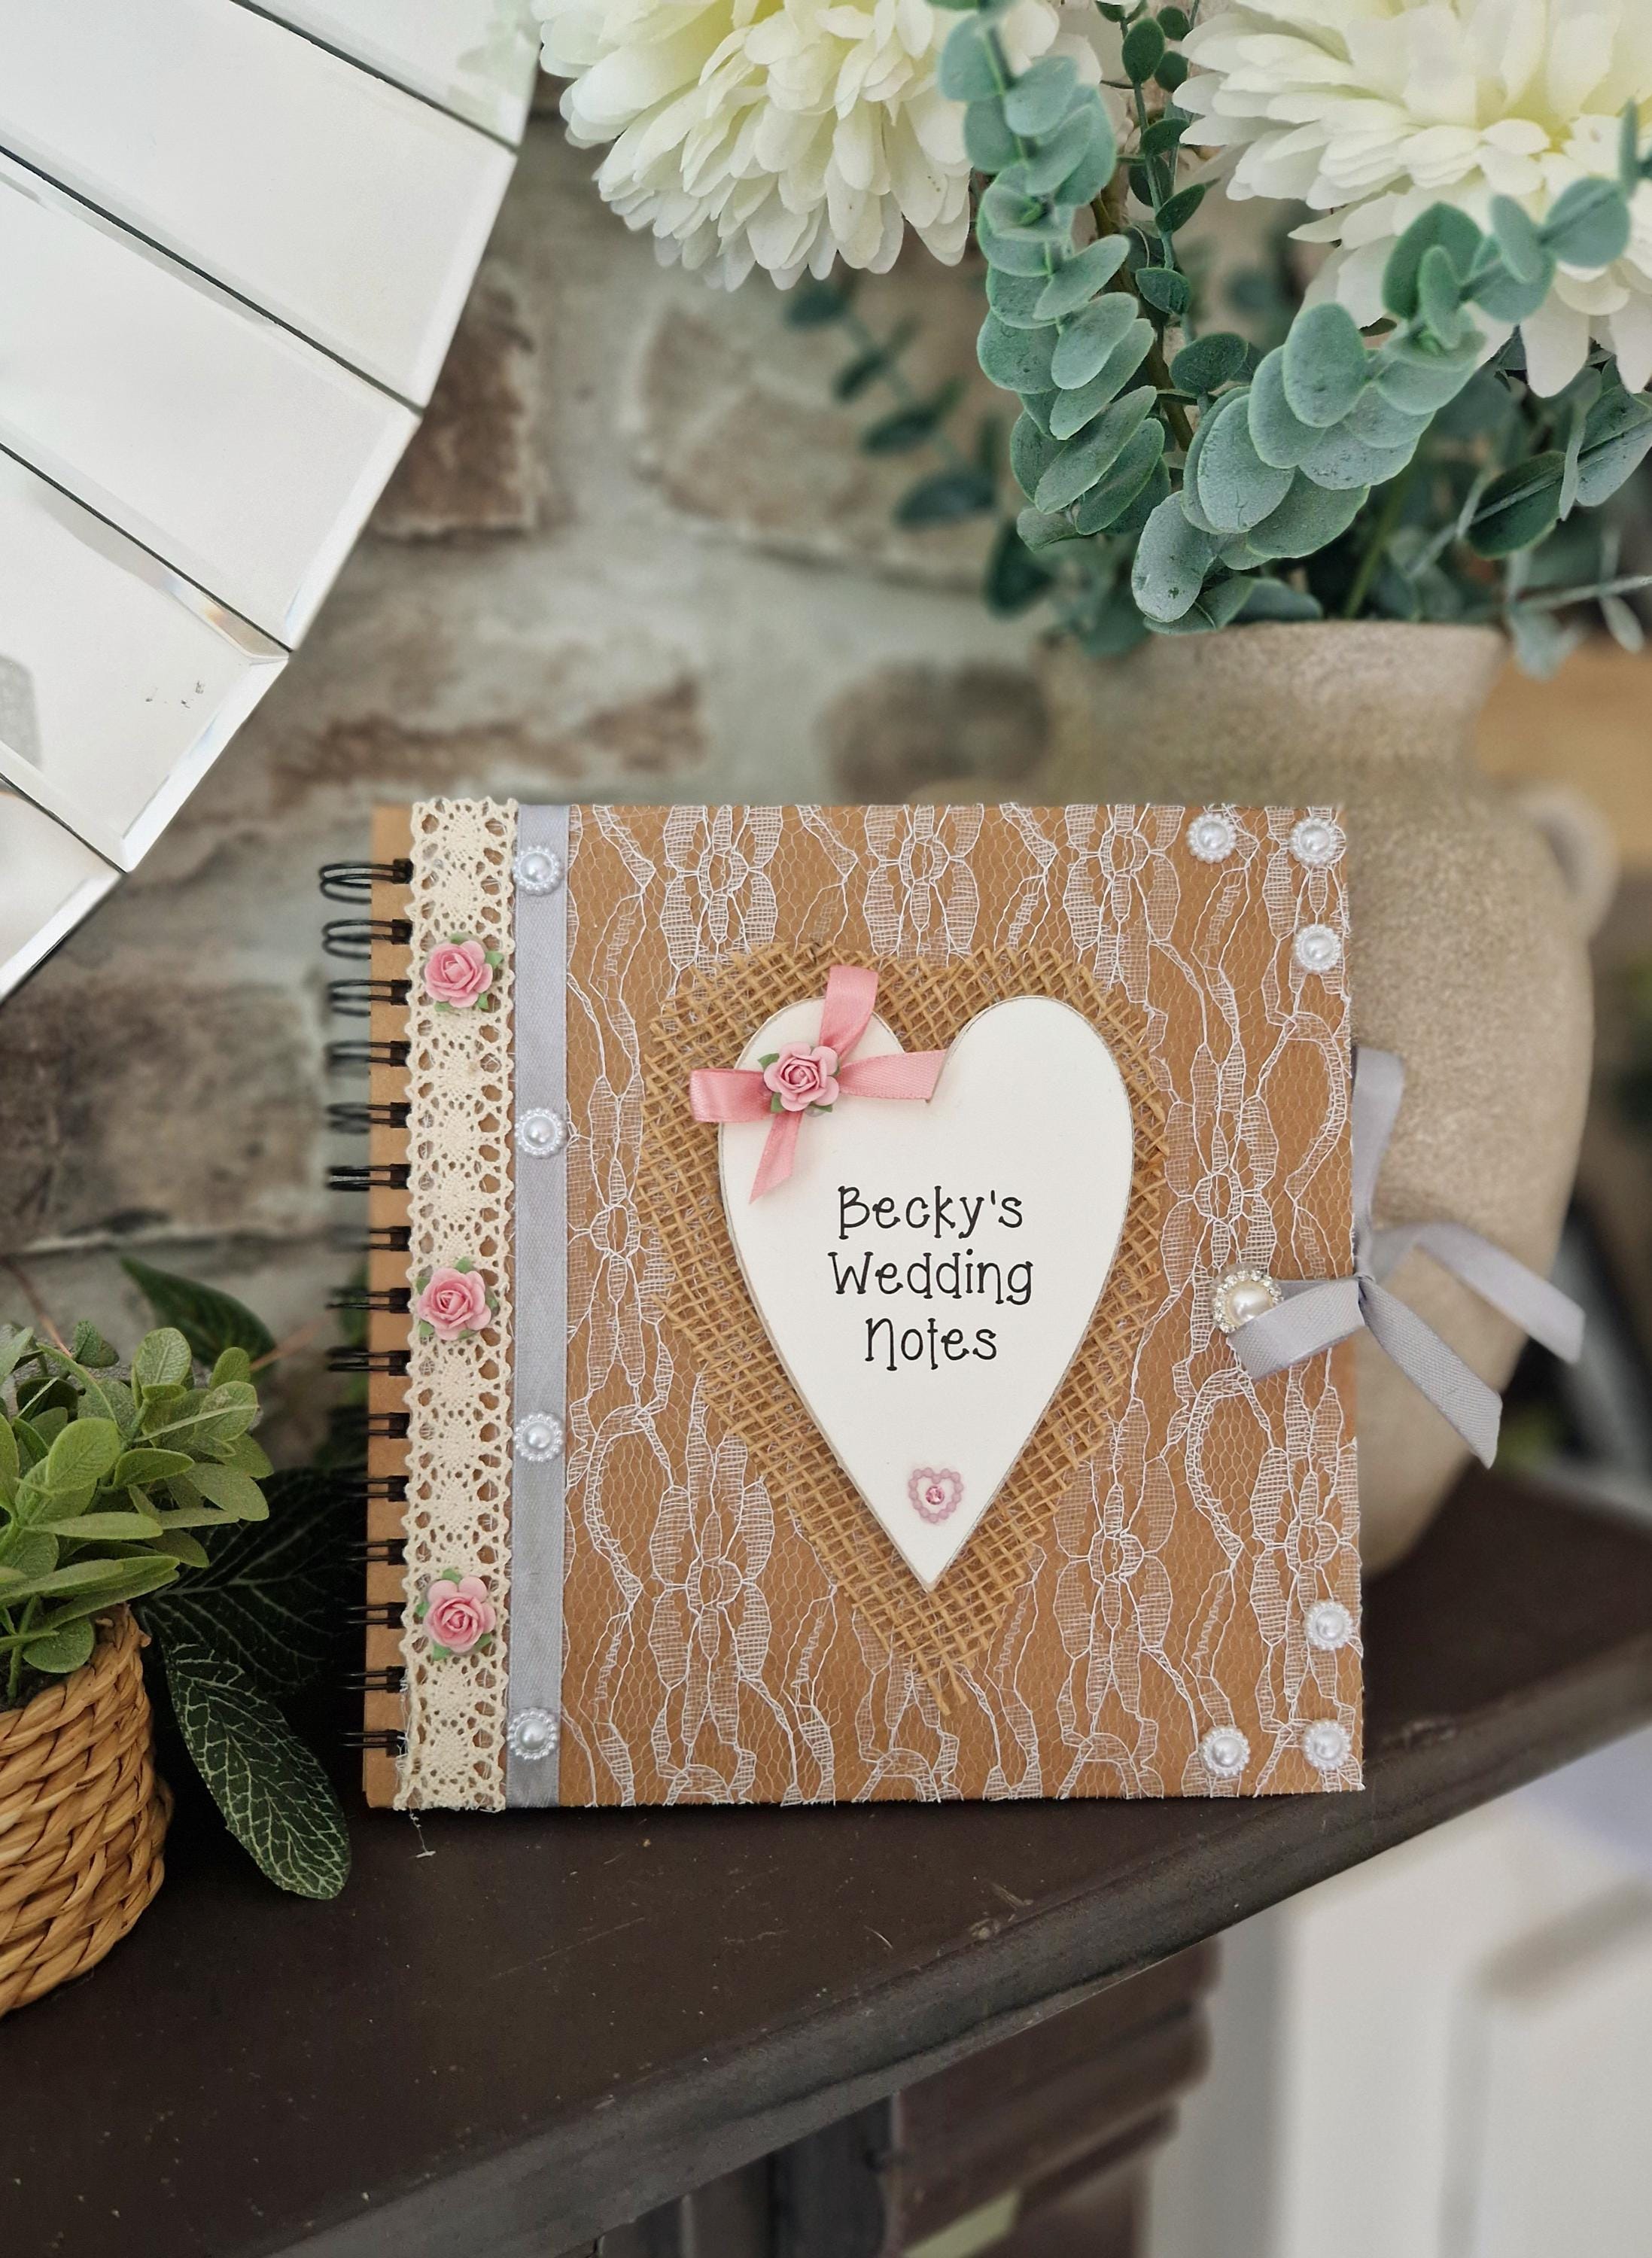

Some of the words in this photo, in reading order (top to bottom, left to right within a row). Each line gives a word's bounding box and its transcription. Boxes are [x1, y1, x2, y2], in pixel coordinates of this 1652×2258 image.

[837, 1185, 1024, 1240] Becky's
[827, 1248, 1034, 1306] Wedding
[864, 1317, 998, 1371] Notes
